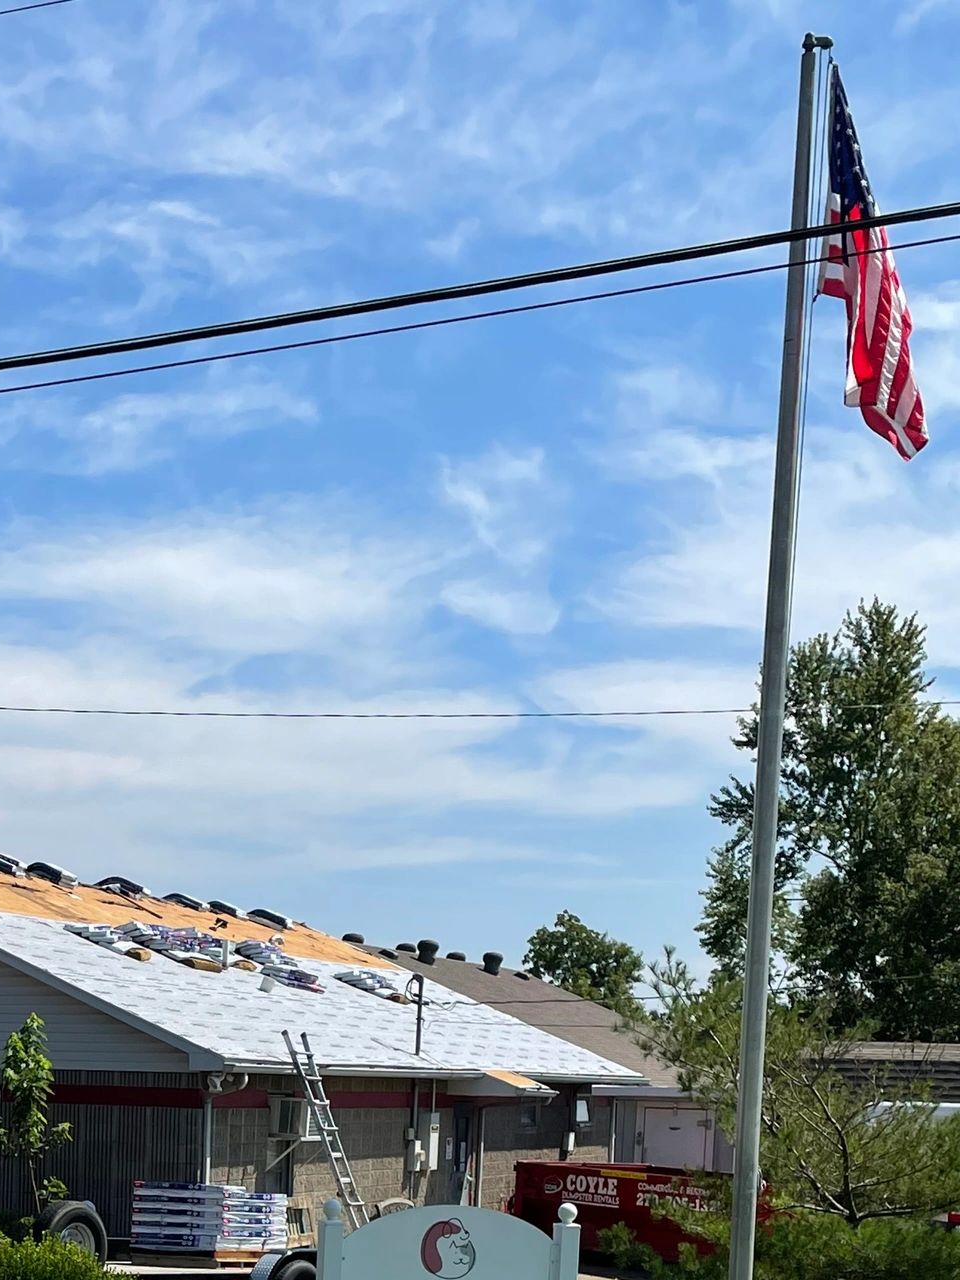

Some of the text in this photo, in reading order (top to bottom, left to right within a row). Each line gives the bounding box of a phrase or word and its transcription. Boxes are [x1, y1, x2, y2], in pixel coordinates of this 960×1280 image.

[566, 1174, 618, 1196] COYLE
[561, 1190, 620, 1205] DUMPSTER RENTALS
